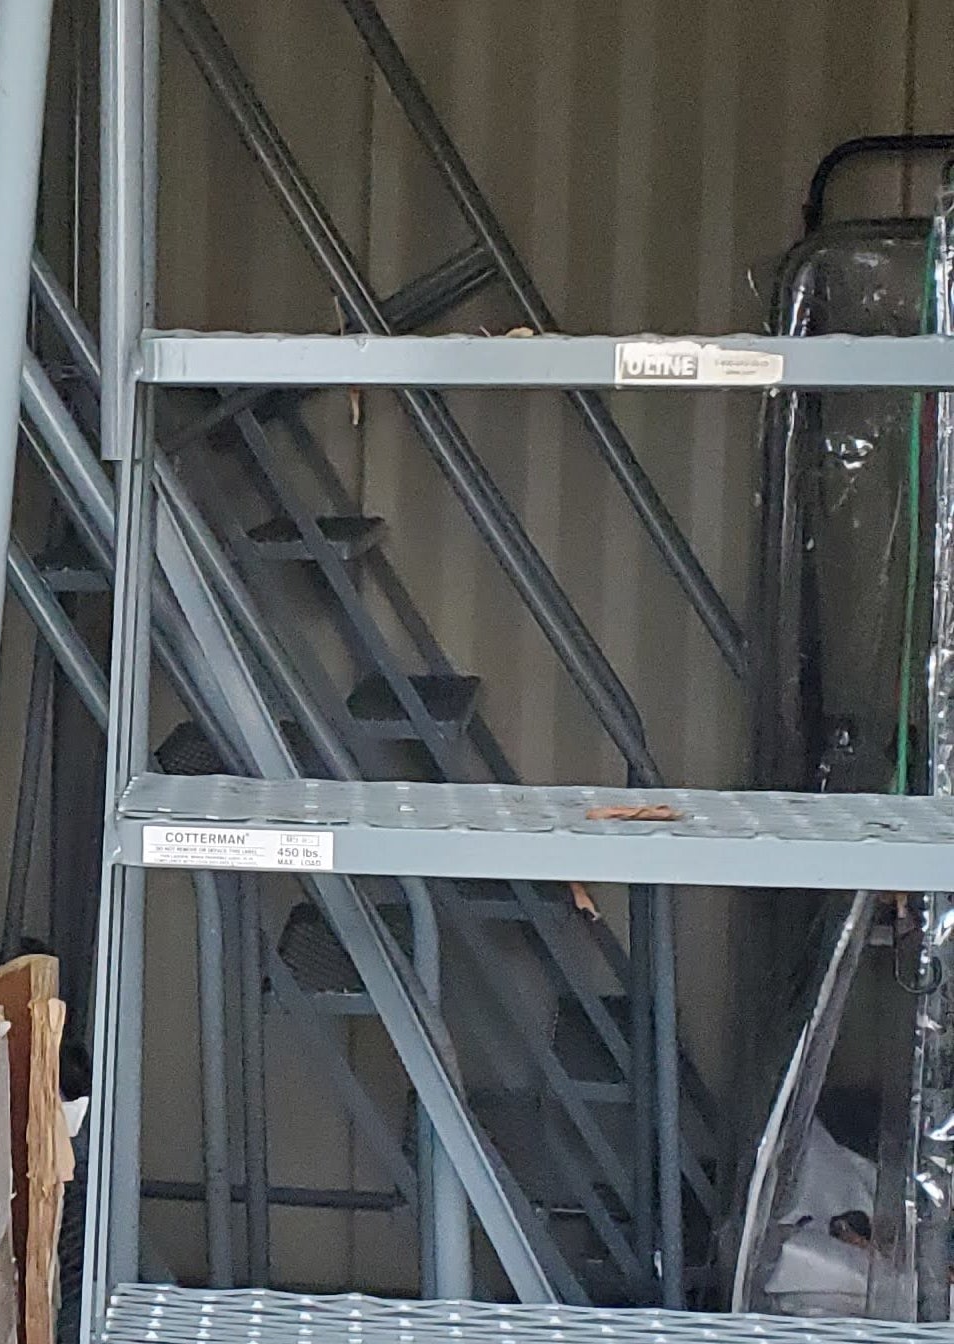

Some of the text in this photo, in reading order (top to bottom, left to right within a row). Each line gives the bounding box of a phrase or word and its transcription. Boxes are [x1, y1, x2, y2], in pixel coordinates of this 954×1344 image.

[165, 832, 245, 845] COTTERMAN
[277, 847, 322, 858] 450 lbs.
